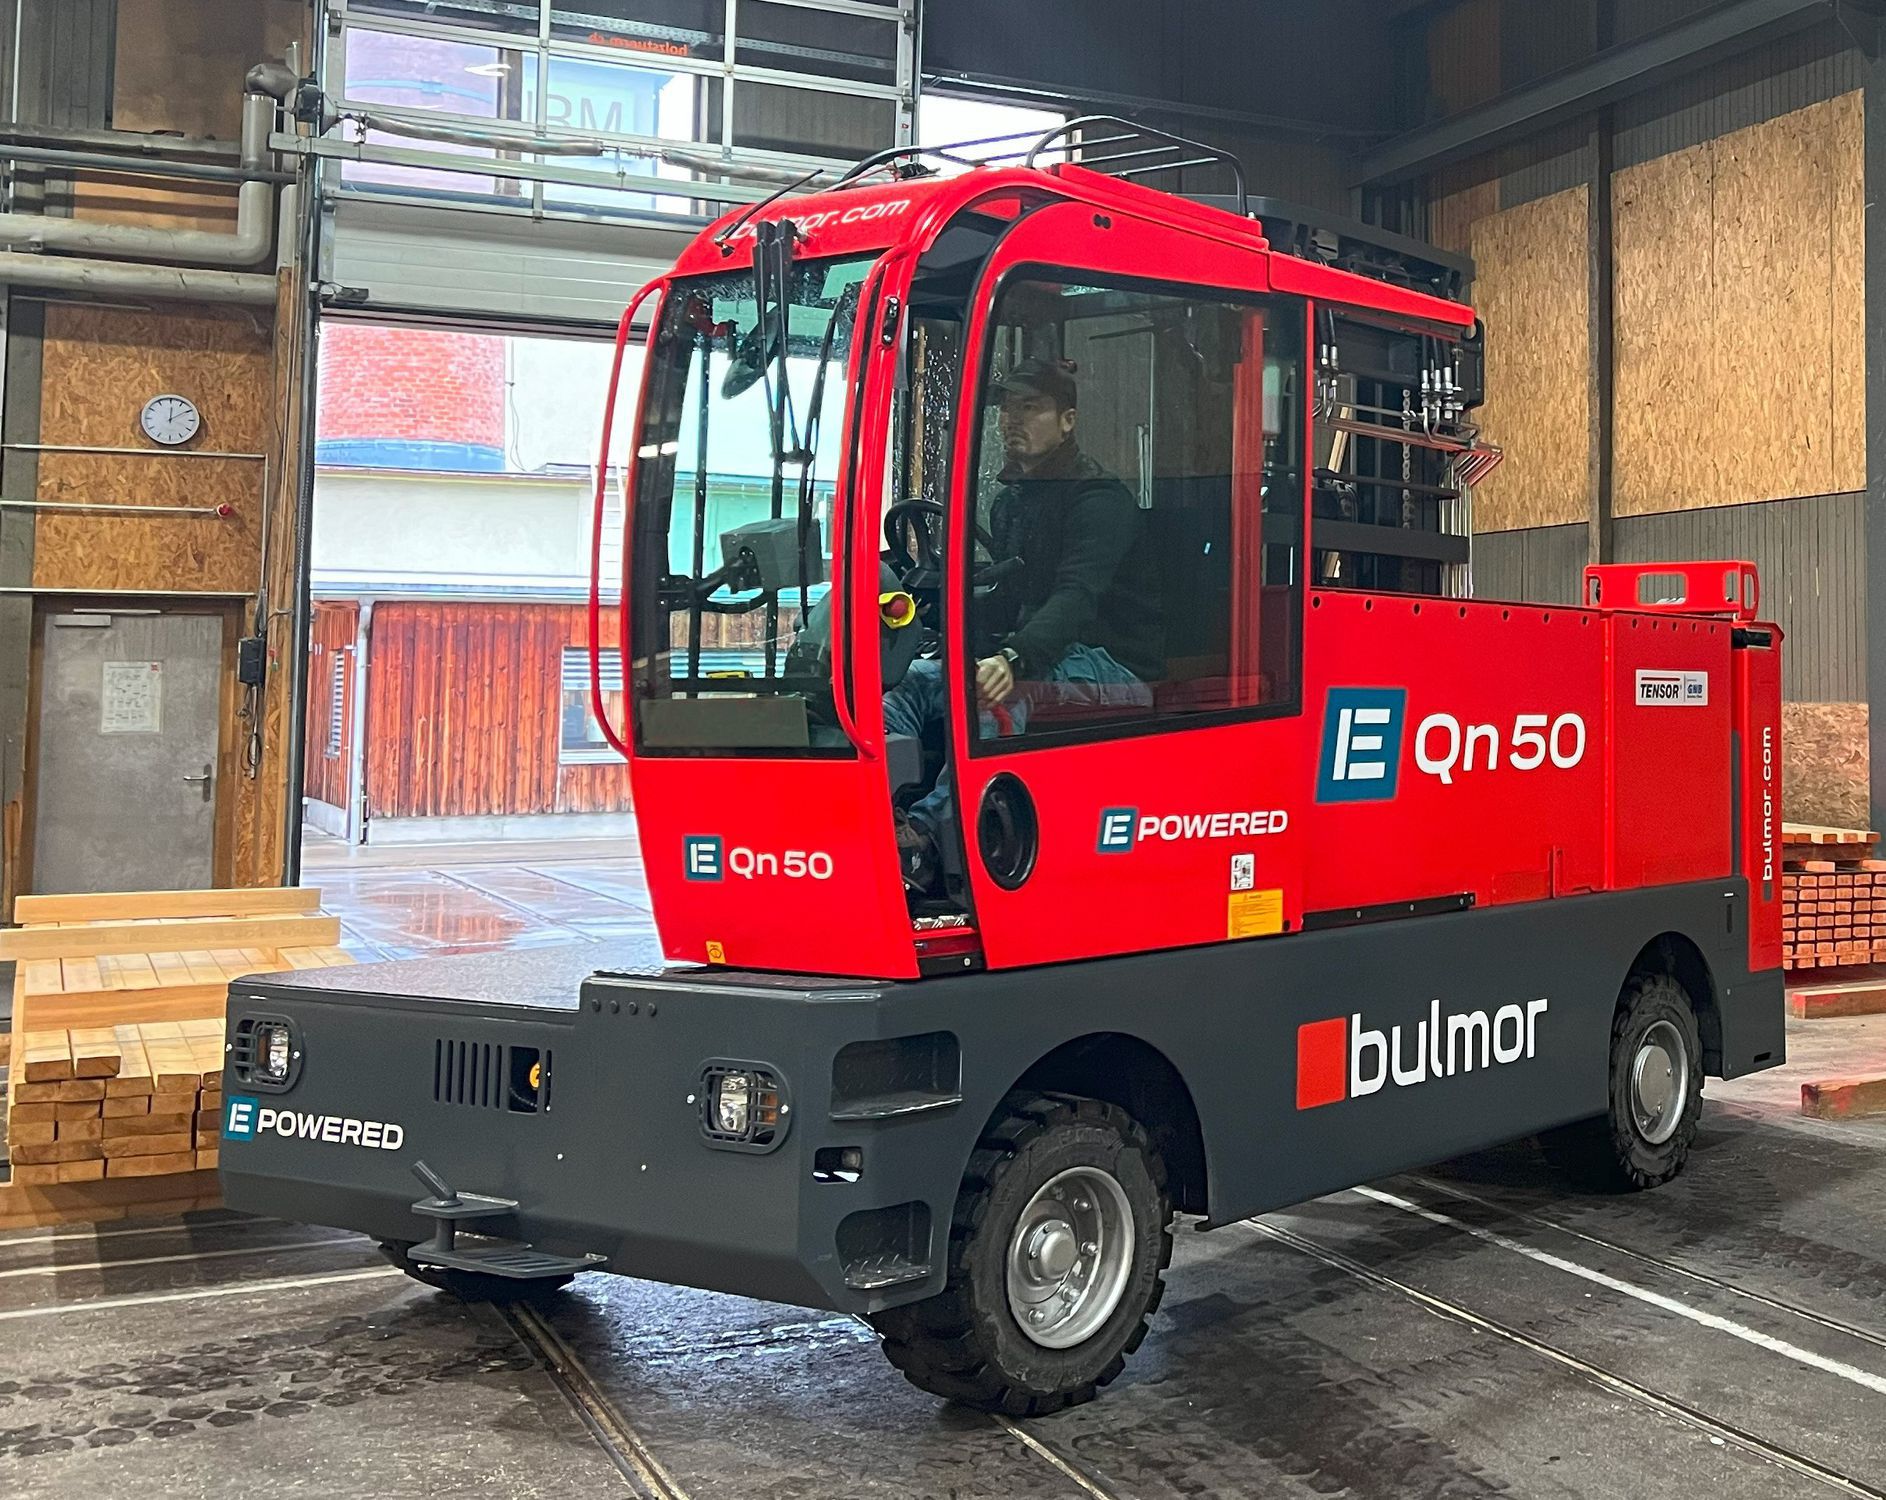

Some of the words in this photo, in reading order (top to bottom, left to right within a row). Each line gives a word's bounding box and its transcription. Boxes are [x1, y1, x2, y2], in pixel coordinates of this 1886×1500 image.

[1640, 684, 1679, 698] TENSOR
[1333, 708, 1391, 780] E
[1415, 713, 1499, 785] Qn
[1509, 713, 1586, 770] 50
[1763, 726, 1773, 881] bulmor.com
[1137, 810, 1288, 842] POWERED
[729, 847, 778, 879] Qn
[783, 850, 833, 880] 50
[1351, 998, 1548, 1098] bulmor
[257, 1108, 404, 1151] POWERED
